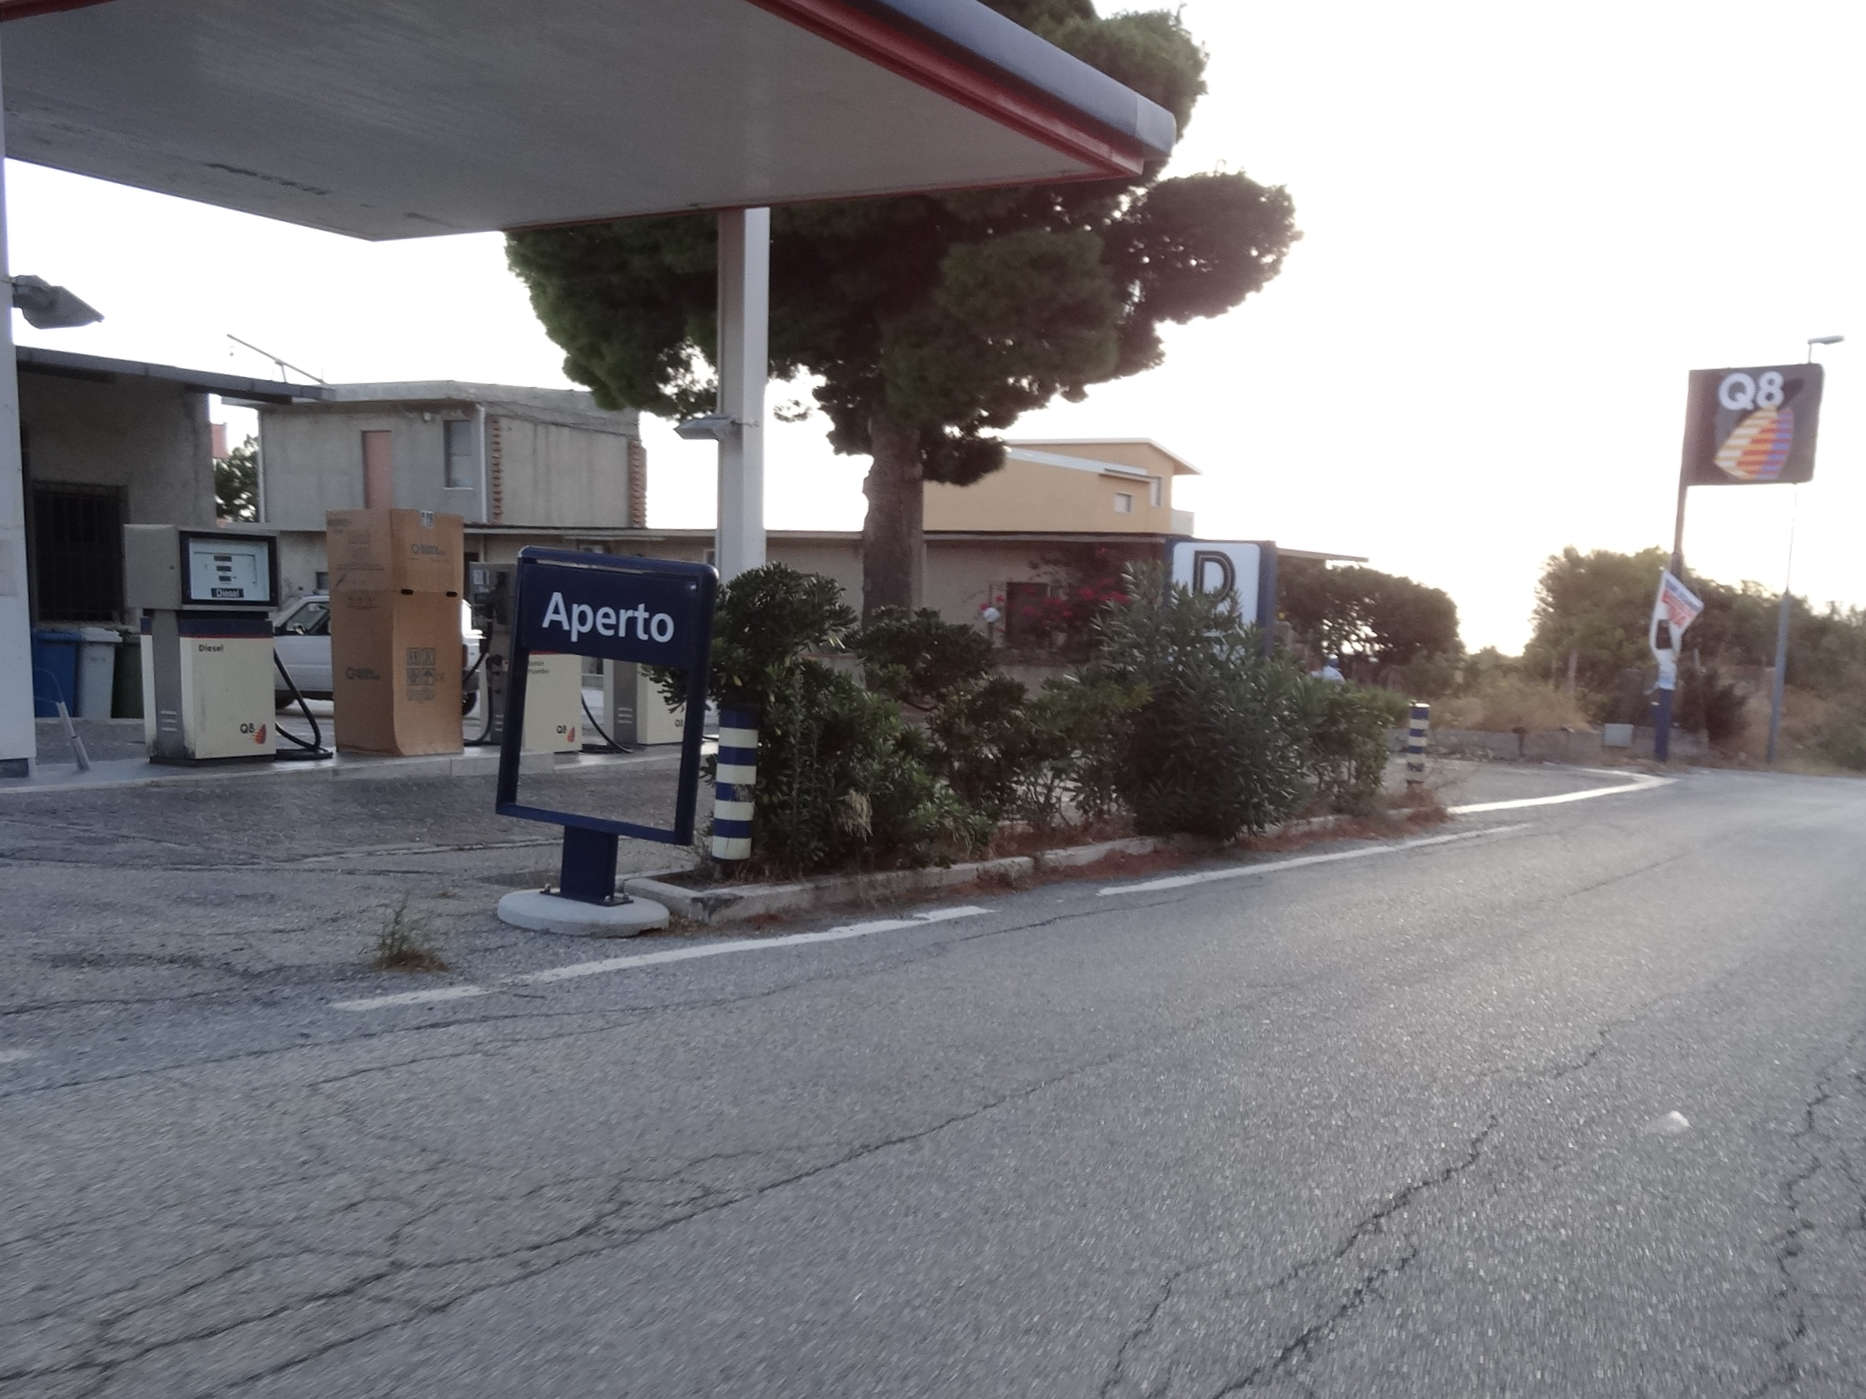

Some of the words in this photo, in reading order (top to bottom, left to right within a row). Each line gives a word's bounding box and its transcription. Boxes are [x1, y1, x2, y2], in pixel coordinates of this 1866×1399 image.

[1718, 371, 1785, 410] Q8
[541, 591, 675, 643] Aperto
[198, 644, 224, 652] Diesel
[240, 722, 255, 734] Q8
